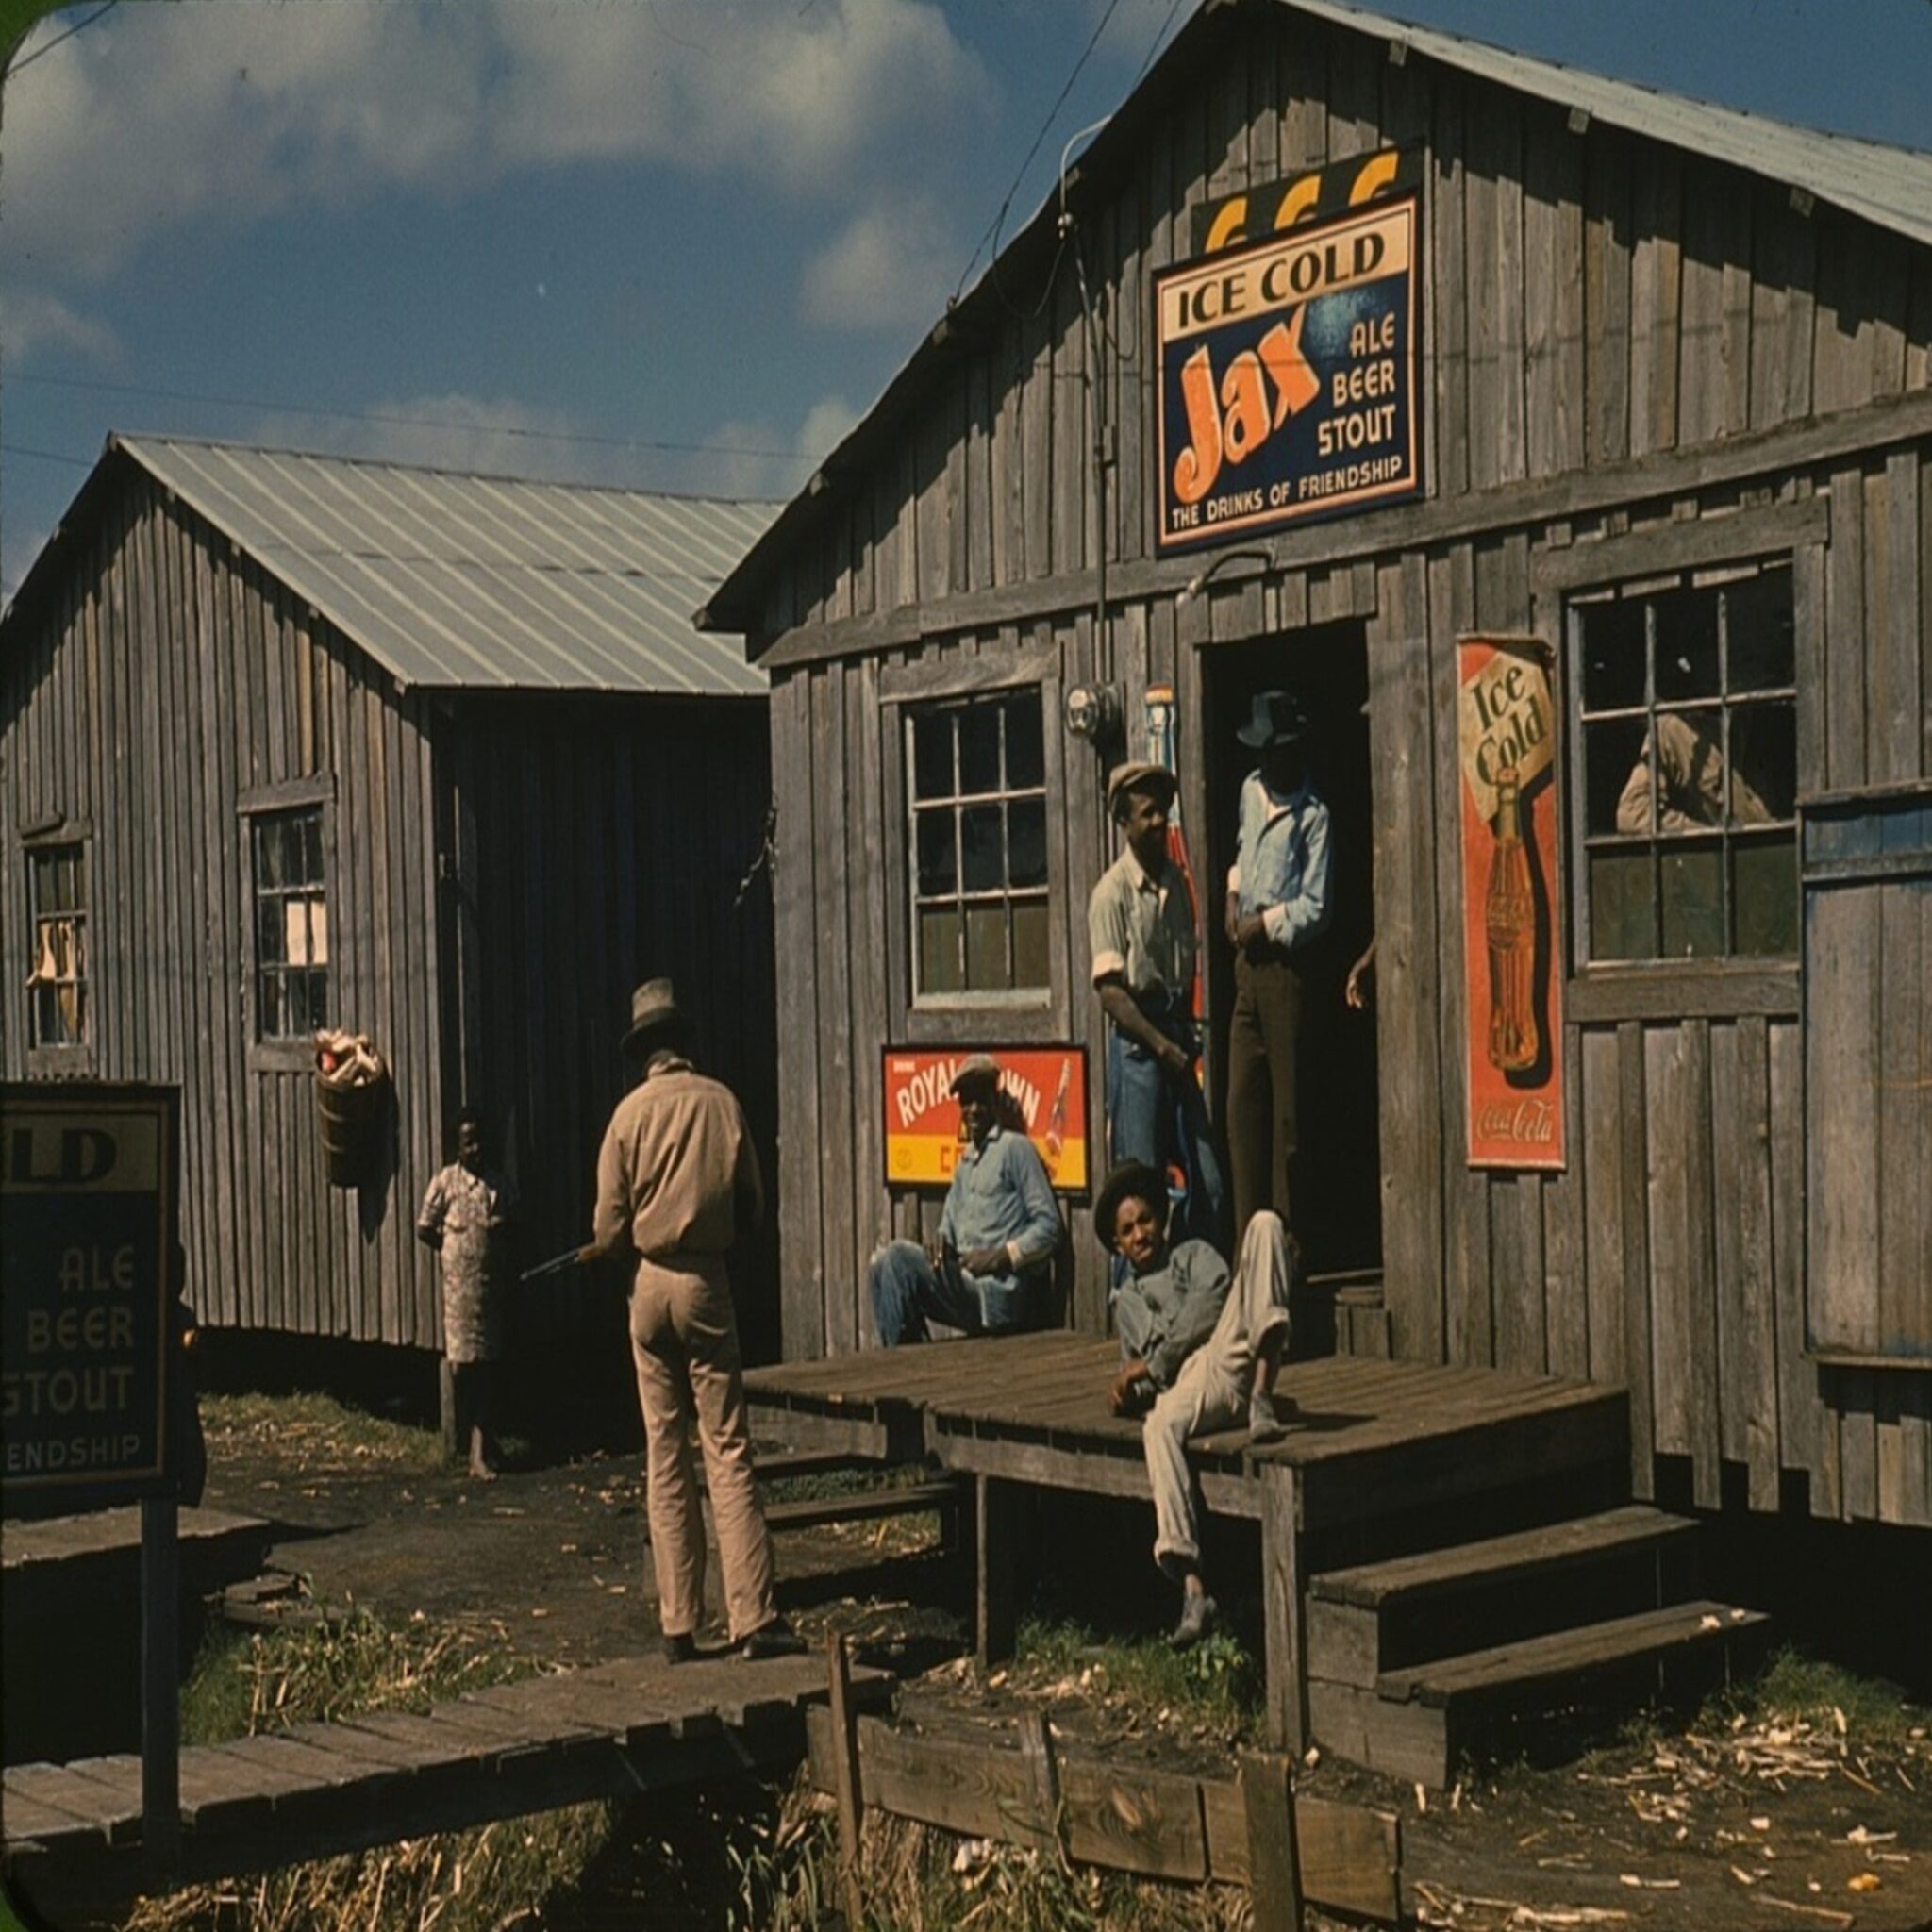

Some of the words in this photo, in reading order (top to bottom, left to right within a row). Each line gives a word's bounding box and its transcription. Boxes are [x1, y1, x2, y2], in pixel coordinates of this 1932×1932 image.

[1178, 272, 1246, 329] ICE
[1261, 231, 1384, 303] COLD
[1350, 311, 1395, 358] ALE
[1173, 303, 1320, 505] Jax
[1332, 369, 1396, 408] BEER
[1317, 404, 1397, 457] STOUT
[1172, 504, 1199, 530] THE
[1207, 488, 1263, 522] DRINKS
[1269, 482, 1291, 507] OF
[1298, 455, 1403, 501] FRIENDSHIP
[1471, 665, 1525, 734] Ice
[1476, 693, 1547, 786] Cold
[0, 1128, 118, 1185] LD
[58, 1245, 135, 1292] ALE
[27, 1306, 135, 1353] BEER
